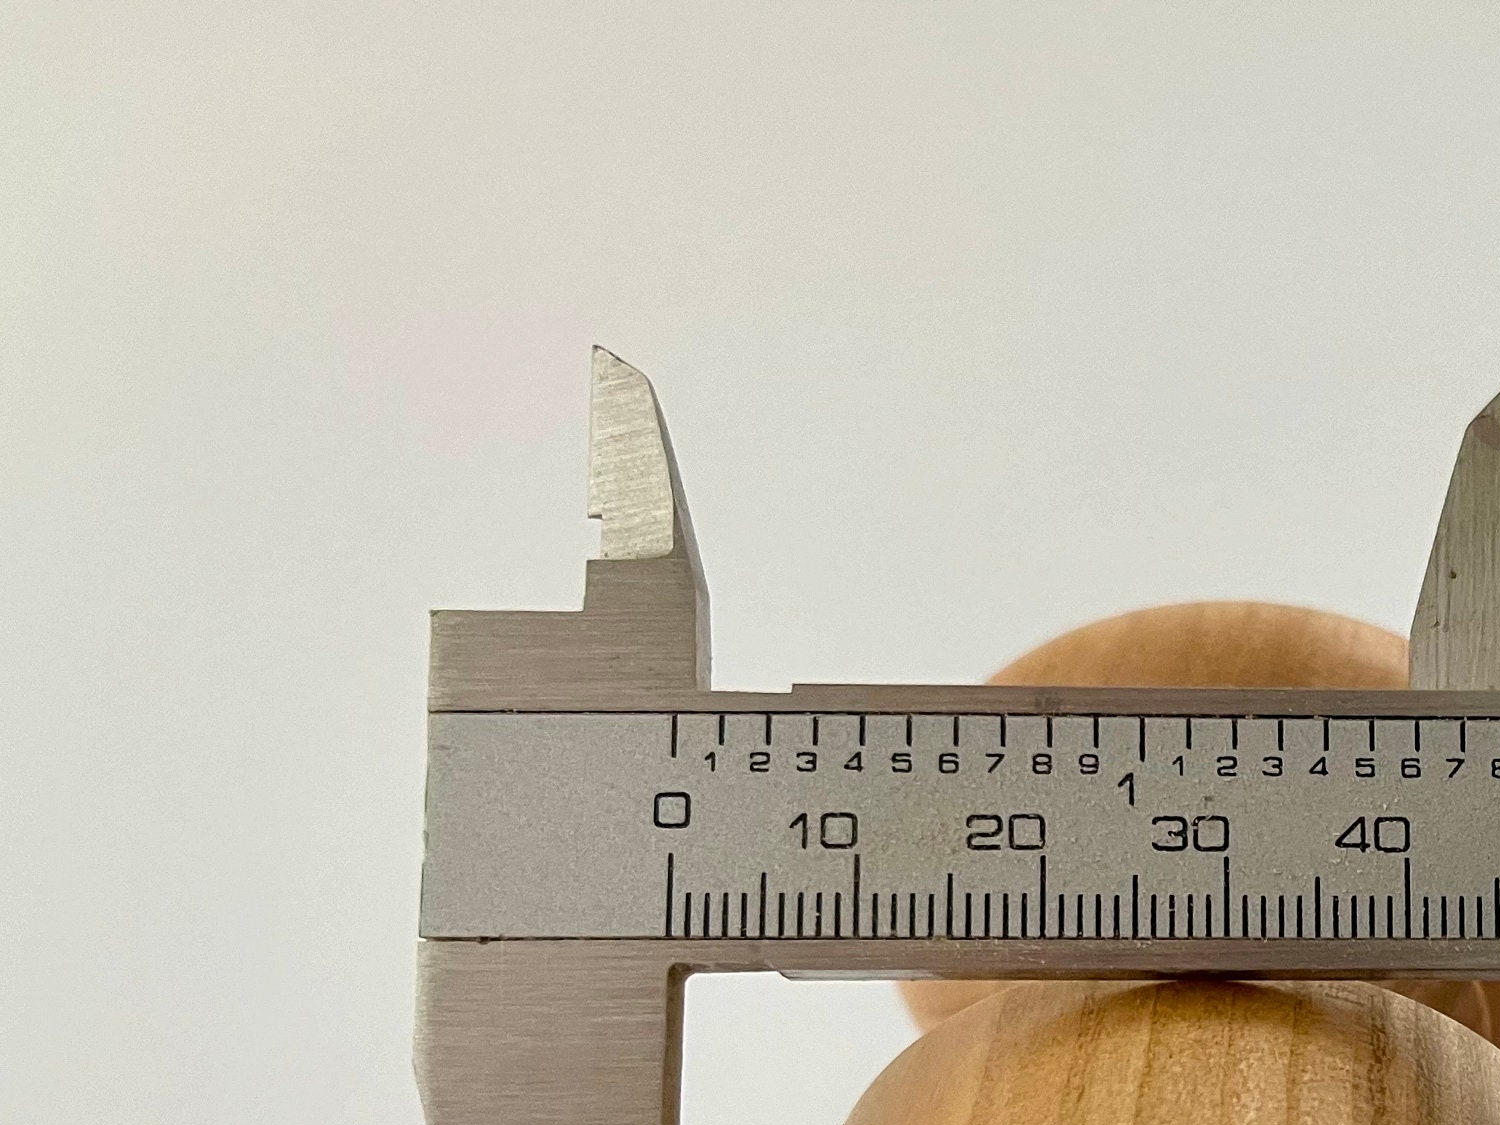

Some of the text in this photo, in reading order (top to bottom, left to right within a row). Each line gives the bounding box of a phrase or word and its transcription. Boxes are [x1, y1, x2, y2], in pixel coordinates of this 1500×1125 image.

[704, 752, 716, 772] 1
[749, 752, 770, 772] 2
[796, 752, 817, 772] 3
[843, 752, 864, 773] 4
[891, 754, 913, 773] 5
[939, 753, 960, 773] 6
[986, 754, 1005, 773] 7
[1032, 754, 1052, 775] 8
[1079, 754, 1099, 774] 9
[1171, 756, 1184, 776] 1
[1217, 757, 1238, 777] 2
[1262, 757, 1284, 777] 3
[1308, 757, 1329, 777] 4
[1354, 757, 1376, 778] 5
[1400, 758, 1421, 778] 6
[1445, 758, 1465, 778] 7
[1117, 772, 1135, 805] 1
[653, 791, 691, 828] 0
[789, 812, 858, 849] 10
[966, 814, 1046, 850] 20
[1150, 815, 1230, 853] 30
[1335, 816, 1410, 854] 40
